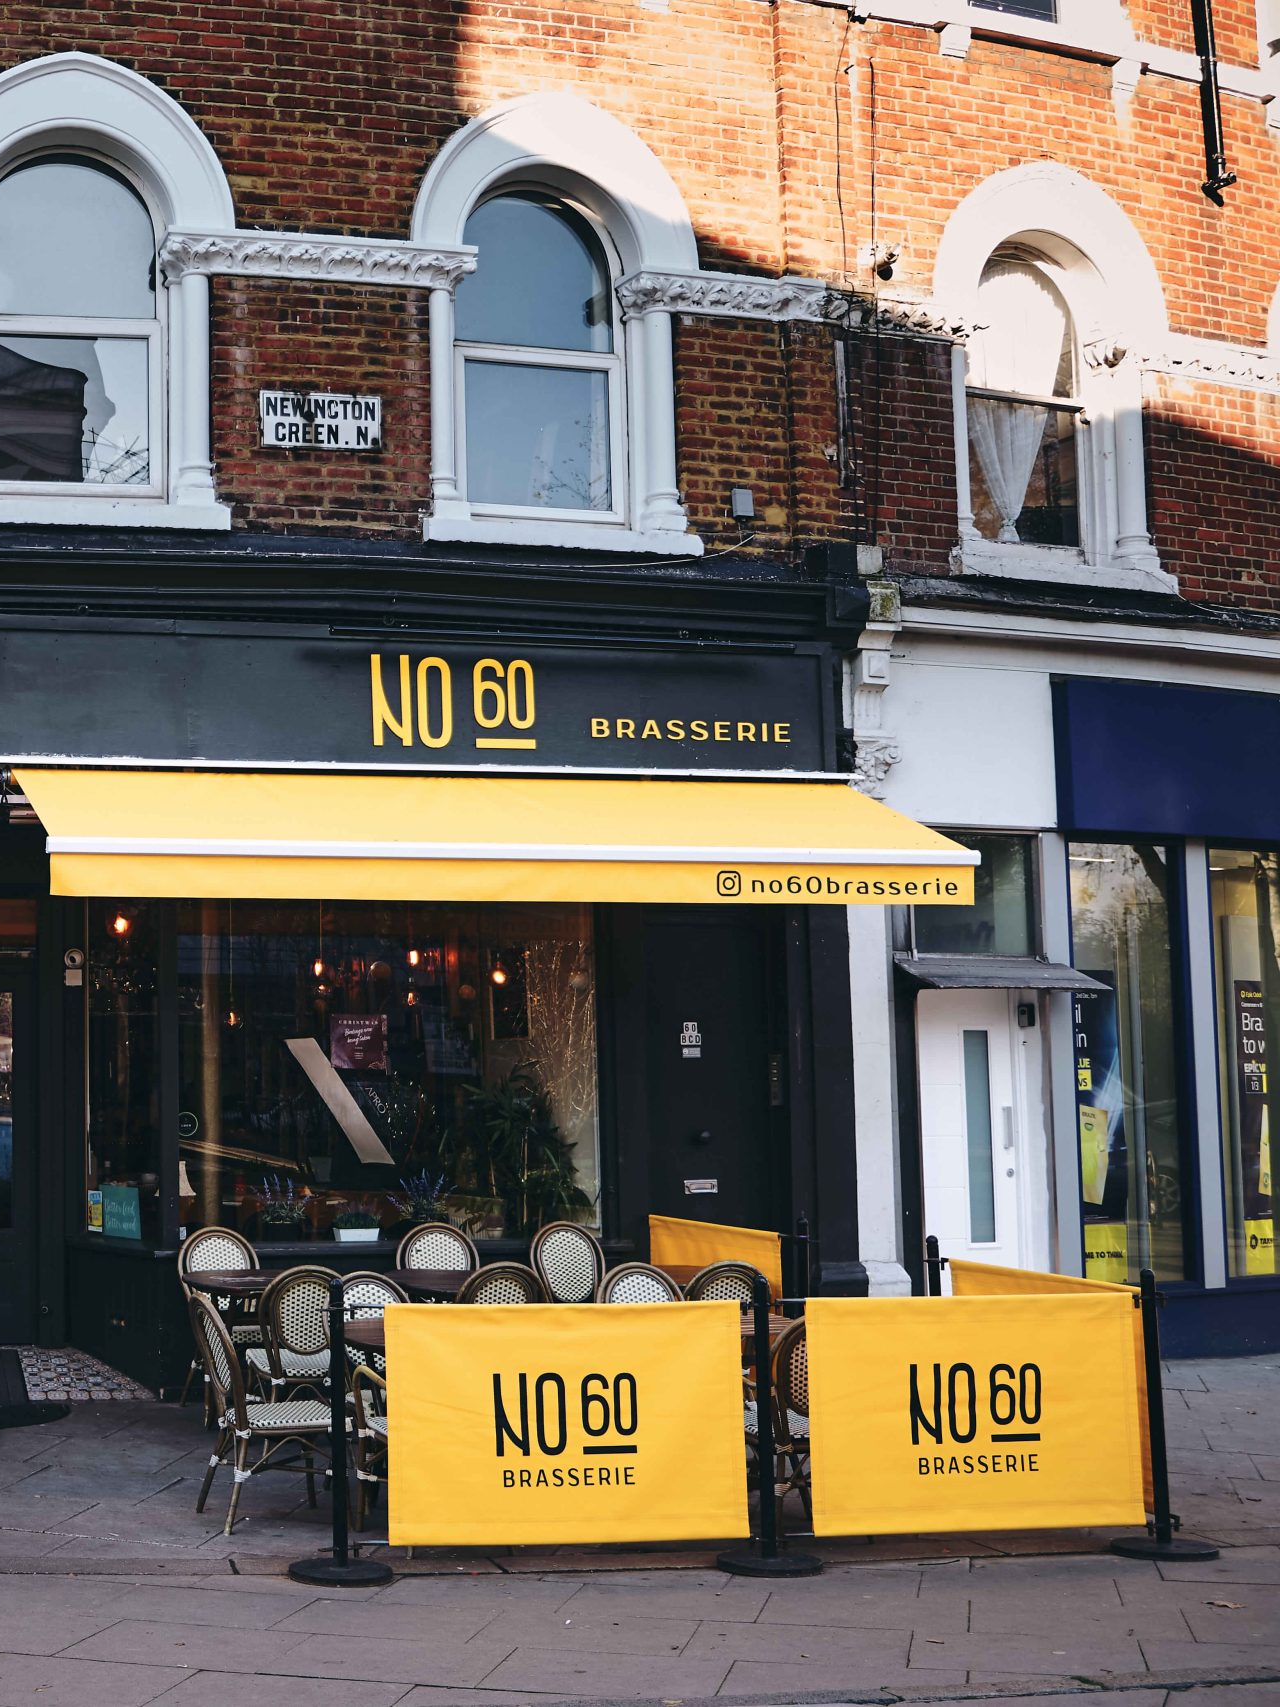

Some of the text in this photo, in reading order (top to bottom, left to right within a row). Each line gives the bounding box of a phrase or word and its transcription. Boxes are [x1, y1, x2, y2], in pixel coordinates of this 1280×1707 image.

[265, 397, 376, 421] NEWINGTON
[370, 654, 792, 748] NO 60 BRASSERIE
[751, 876, 958, 896] no60brasserie
[684, 1023, 697, 1032] 60
[1241, 1012, 1264, 1031] Bra
[681, 1034, 700, 1044] BCD
[493, 1372, 638, 1457] NO 60
[910, 1363, 1041, 1446] NO 60
[919, 1454, 1039, 1475] BRASSERIE
[503, 1467, 636, 1488] BRASSERIE
